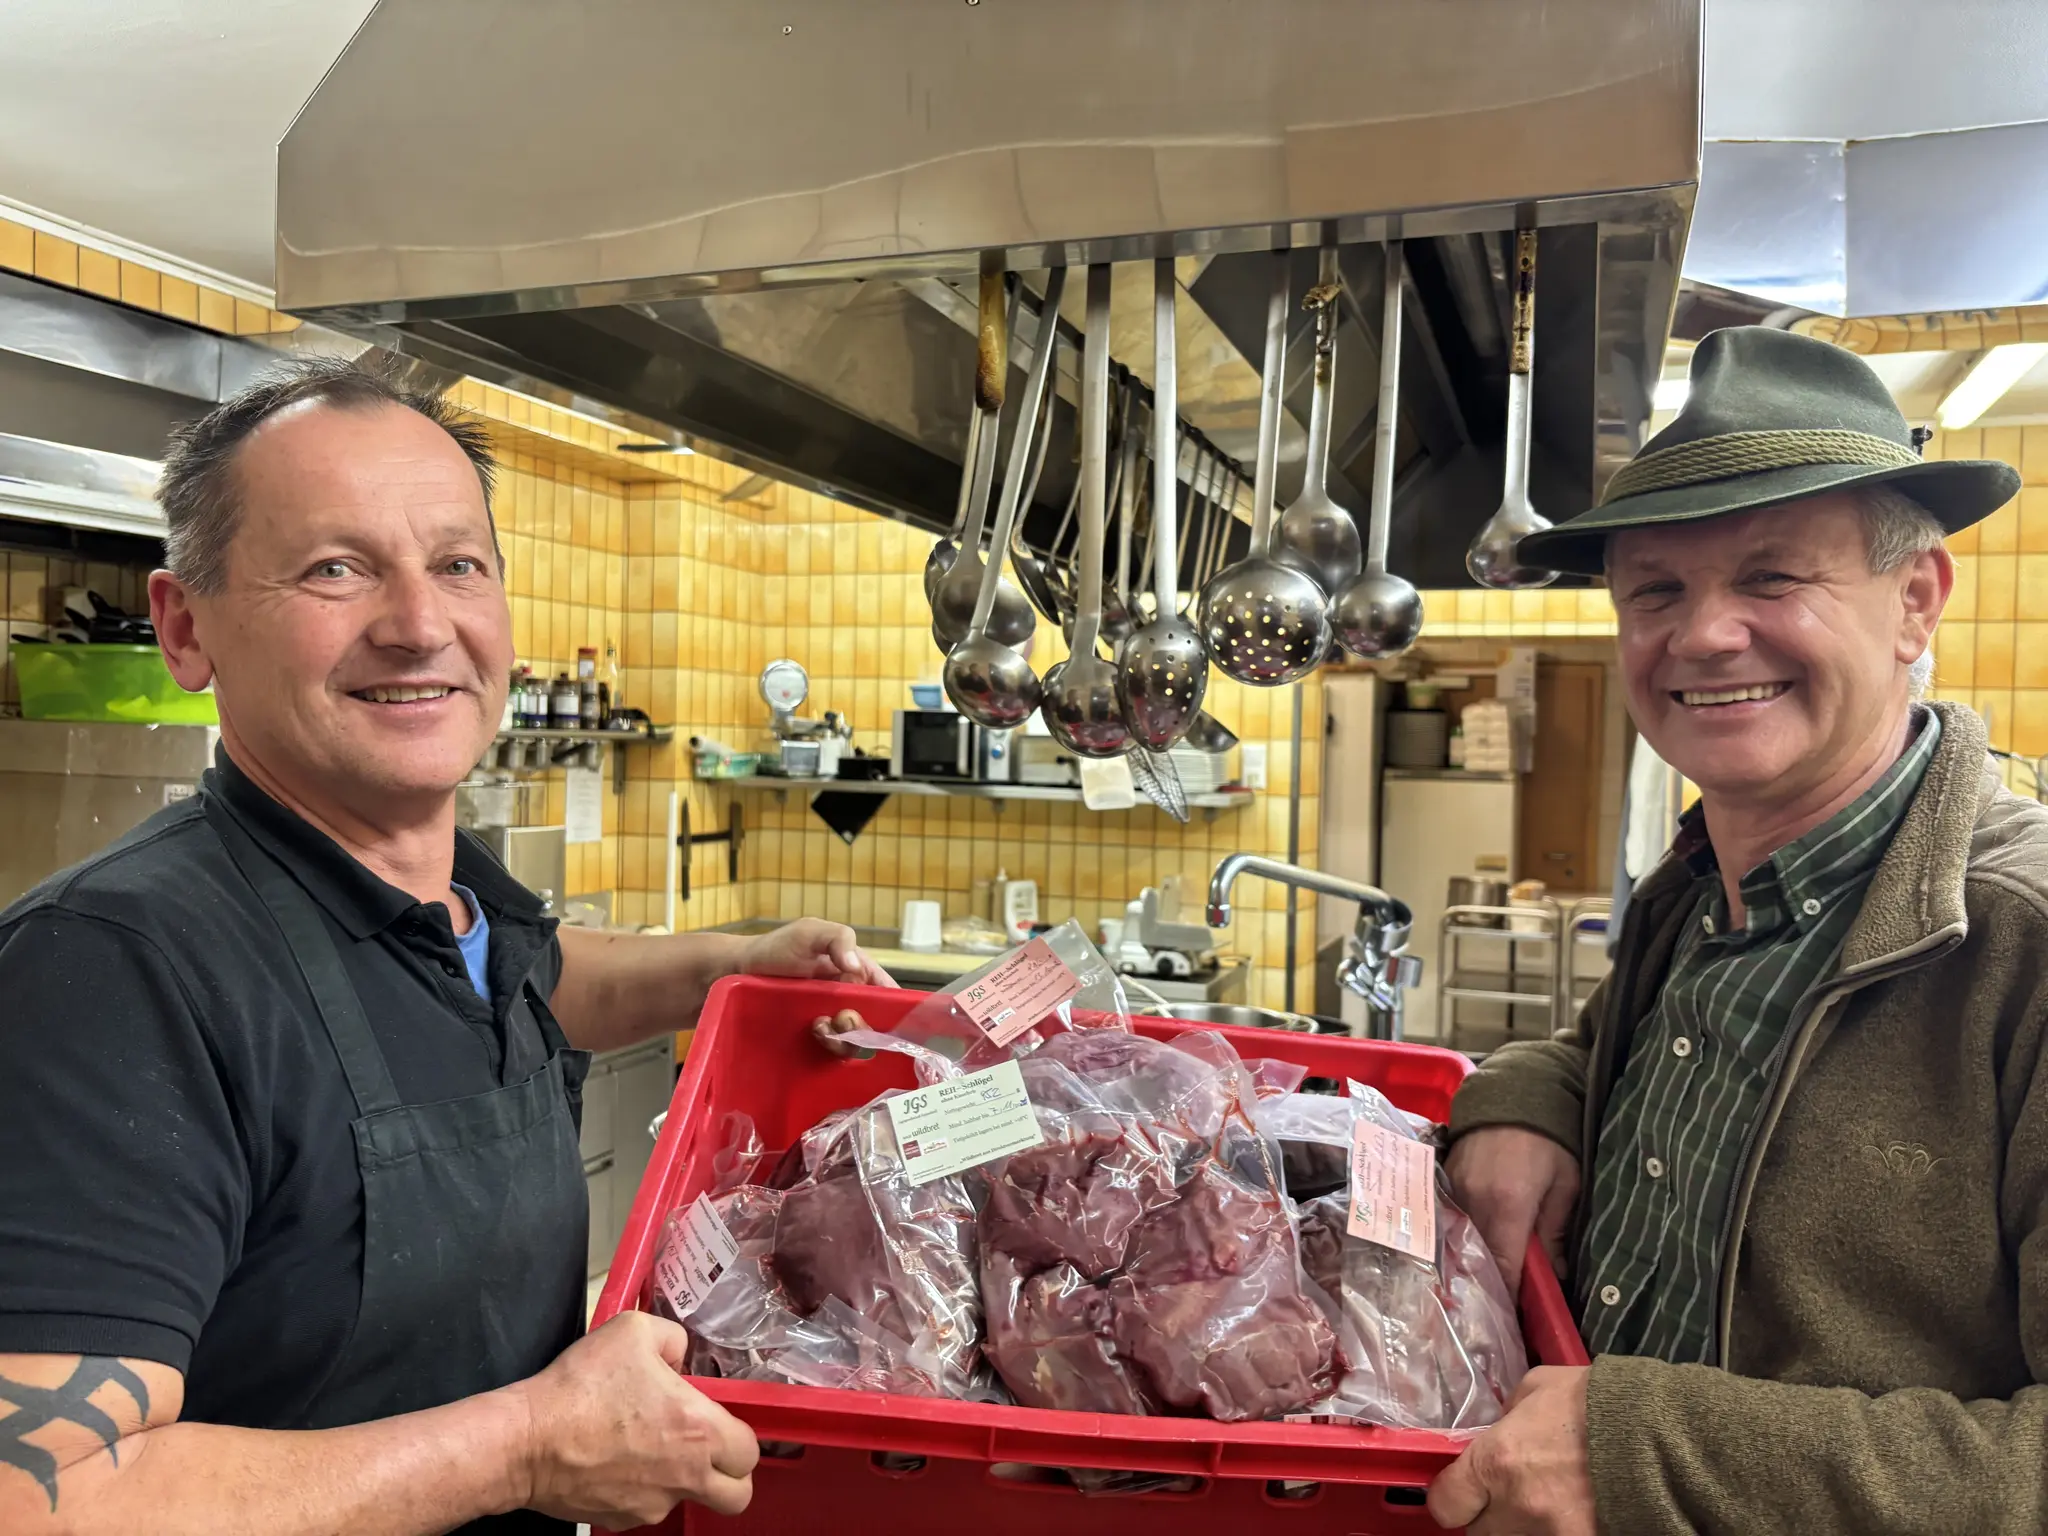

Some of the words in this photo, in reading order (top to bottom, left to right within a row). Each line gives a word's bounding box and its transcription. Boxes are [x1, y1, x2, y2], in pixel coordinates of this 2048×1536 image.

[968, 985, 986, 1003] JGS
[903, 1094, 928, 1114] JGS
[912, 1123, 940, 1137] wildbret
